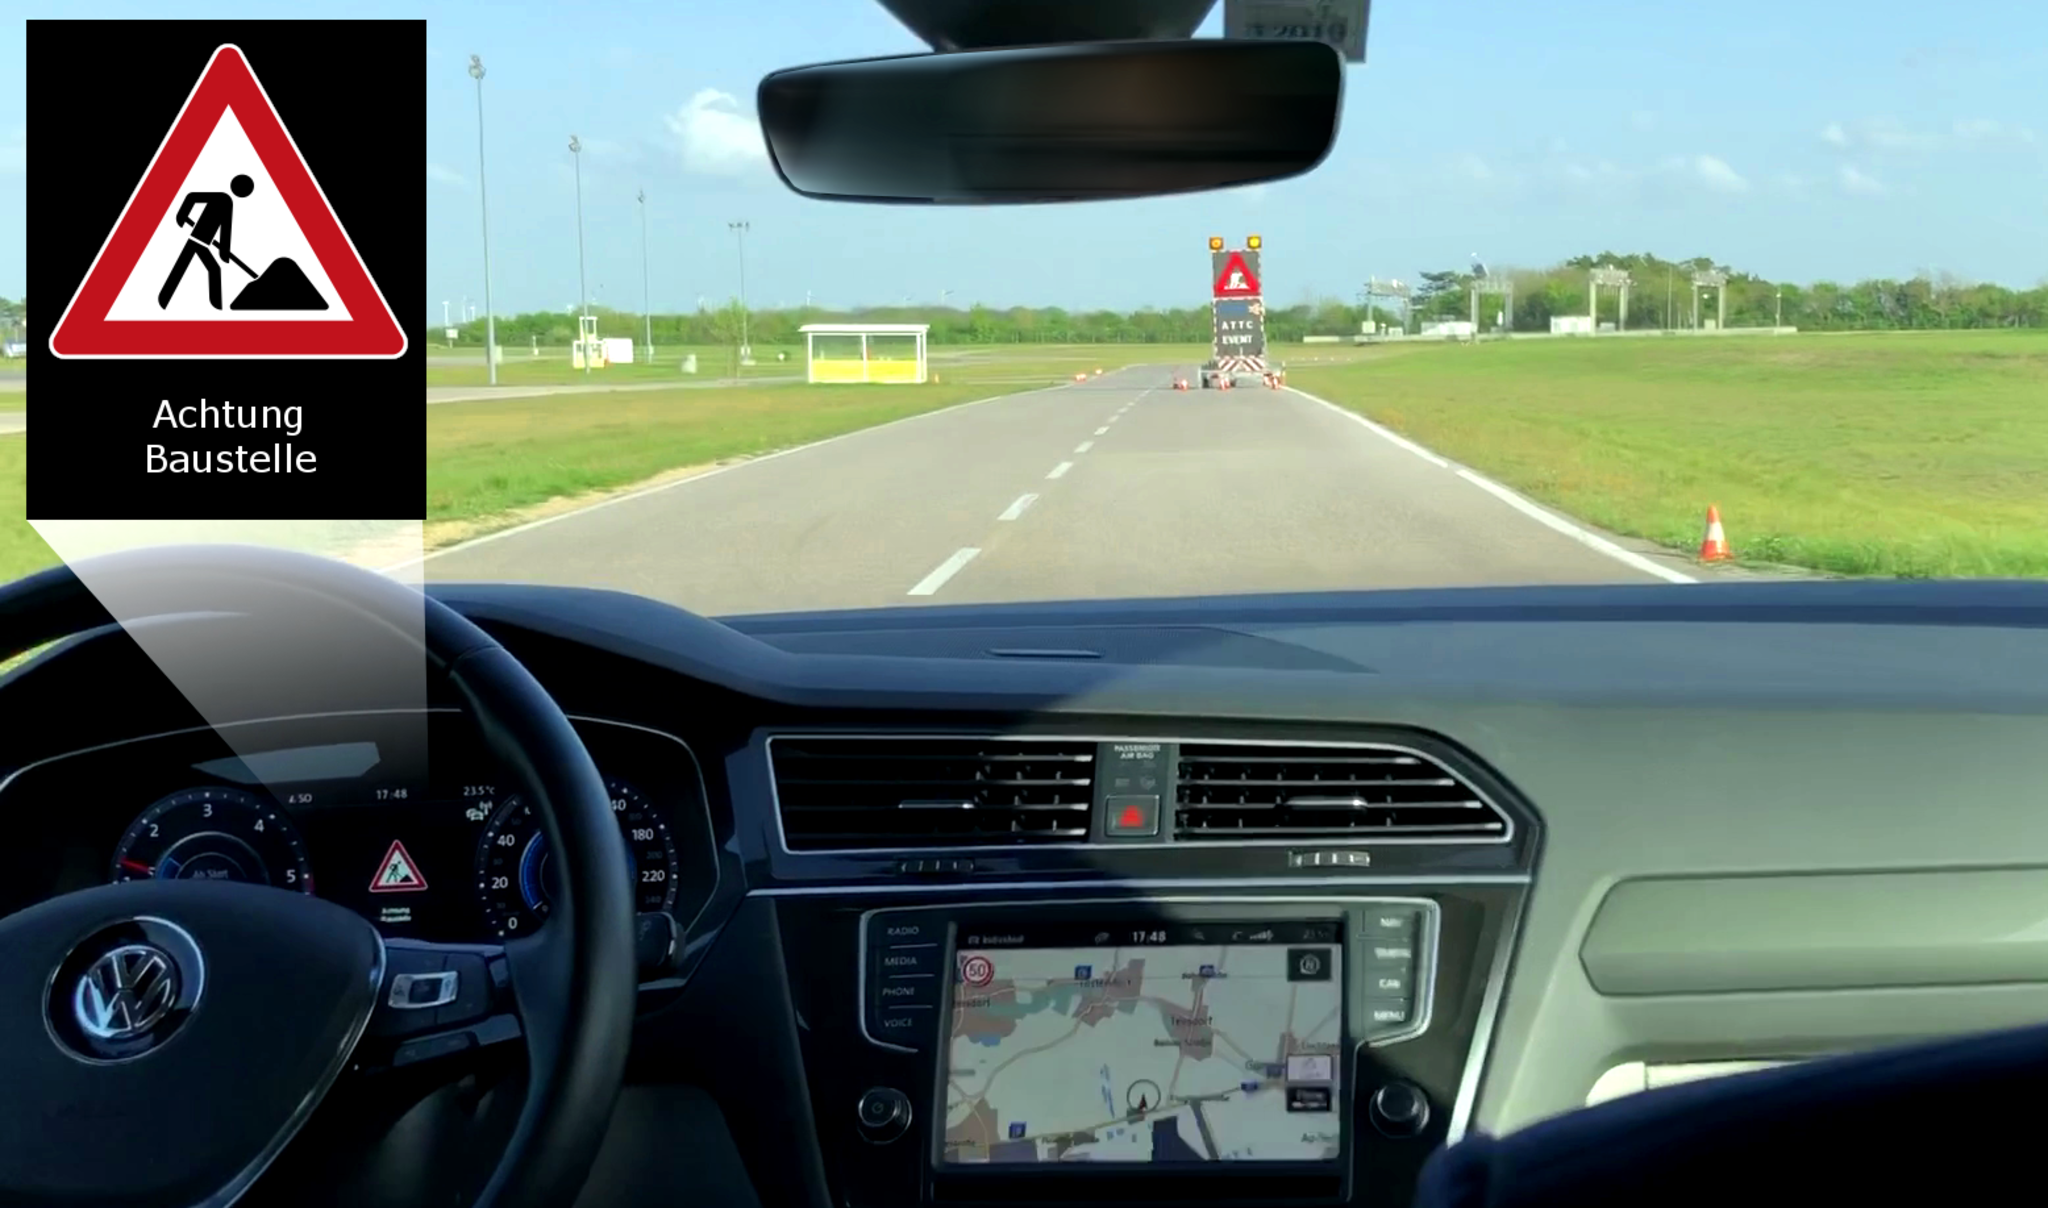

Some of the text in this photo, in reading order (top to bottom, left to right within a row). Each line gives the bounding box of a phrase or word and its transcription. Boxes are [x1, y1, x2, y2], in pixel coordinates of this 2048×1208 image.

[1221, 320, 1254, 331] ATTC
[1221, 334, 1253, 346] EVENT
[375, 788, 408, 801] 17:48
[202, 803, 214, 819] 3
[149, 823, 160, 838] 2
[253, 818, 266, 833] 4
[496, 833, 516, 848] 40
[631, 827, 654, 842] 180
[286, 868, 297, 884] 5
[490, 875, 509, 890] 20
[641, 869, 666, 884] 220
[507, 916, 519, 931] 0
[886, 925, 920, 936] RADIO
[1132, 930, 1168, 943] 17:48
[884, 956, 918, 967] MEDIA
[968, 963, 987, 978] 50
[881, 987, 916, 997] PHONE
[883, 1018, 913, 1028] VOICE
